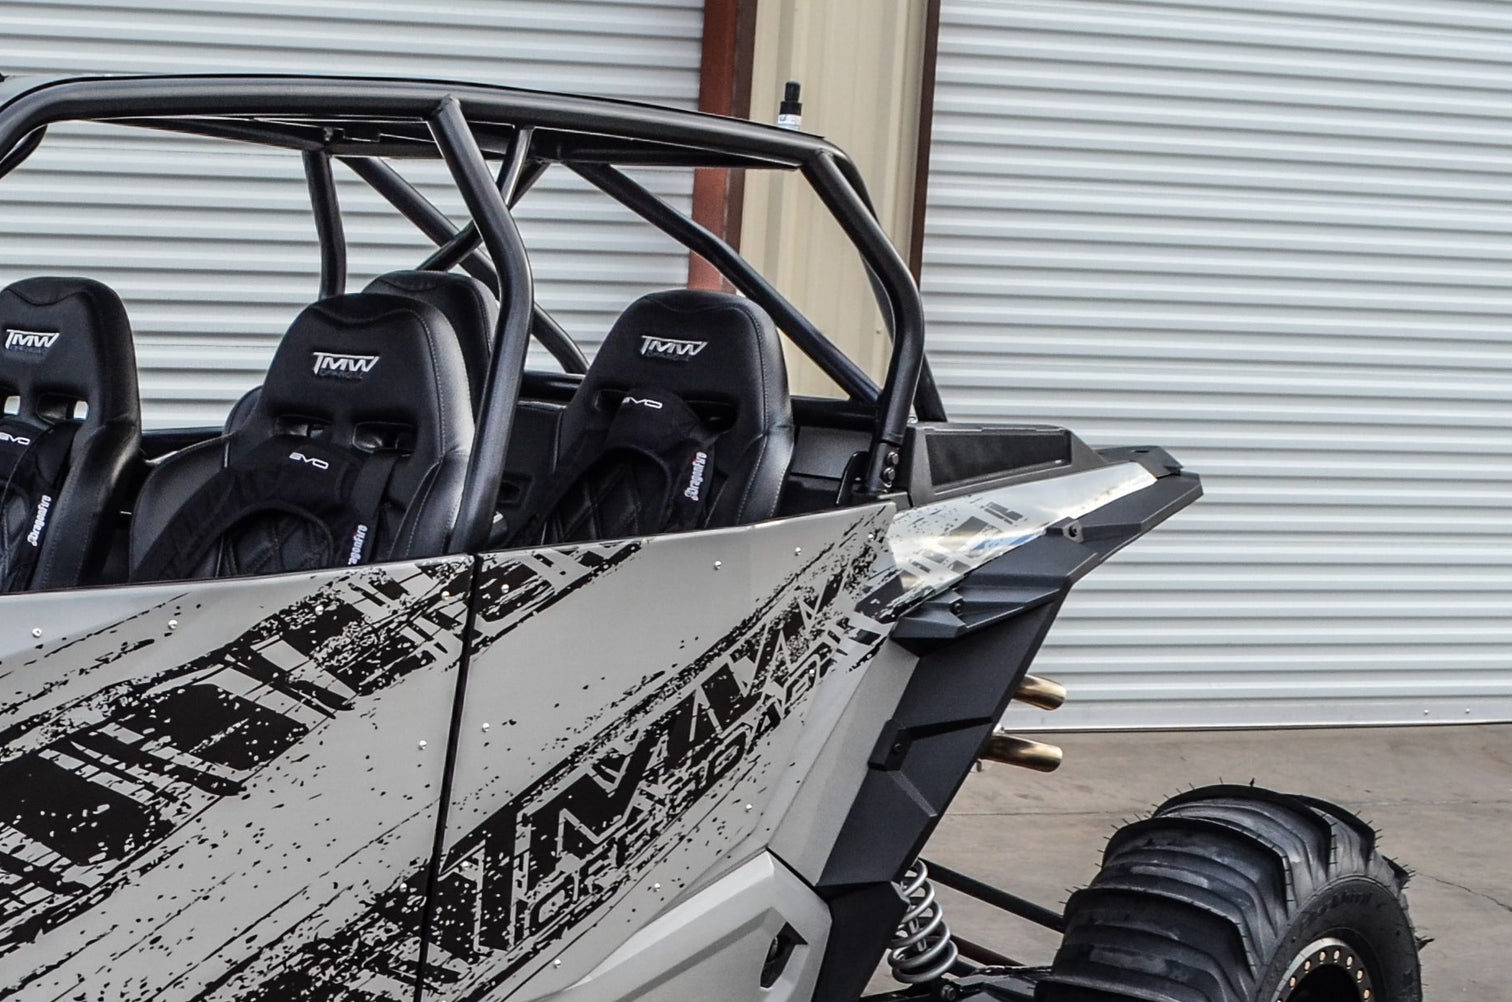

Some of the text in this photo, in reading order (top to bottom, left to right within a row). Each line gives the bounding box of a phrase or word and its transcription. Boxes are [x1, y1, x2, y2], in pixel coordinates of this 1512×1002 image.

[5, 329, 60, 349] TMW
[640, 335, 708, 355] TMW
[313, 352, 380, 375] TMW
[289, 452, 329, 470] EVO
[348, 524, 368, 565] agonfire
